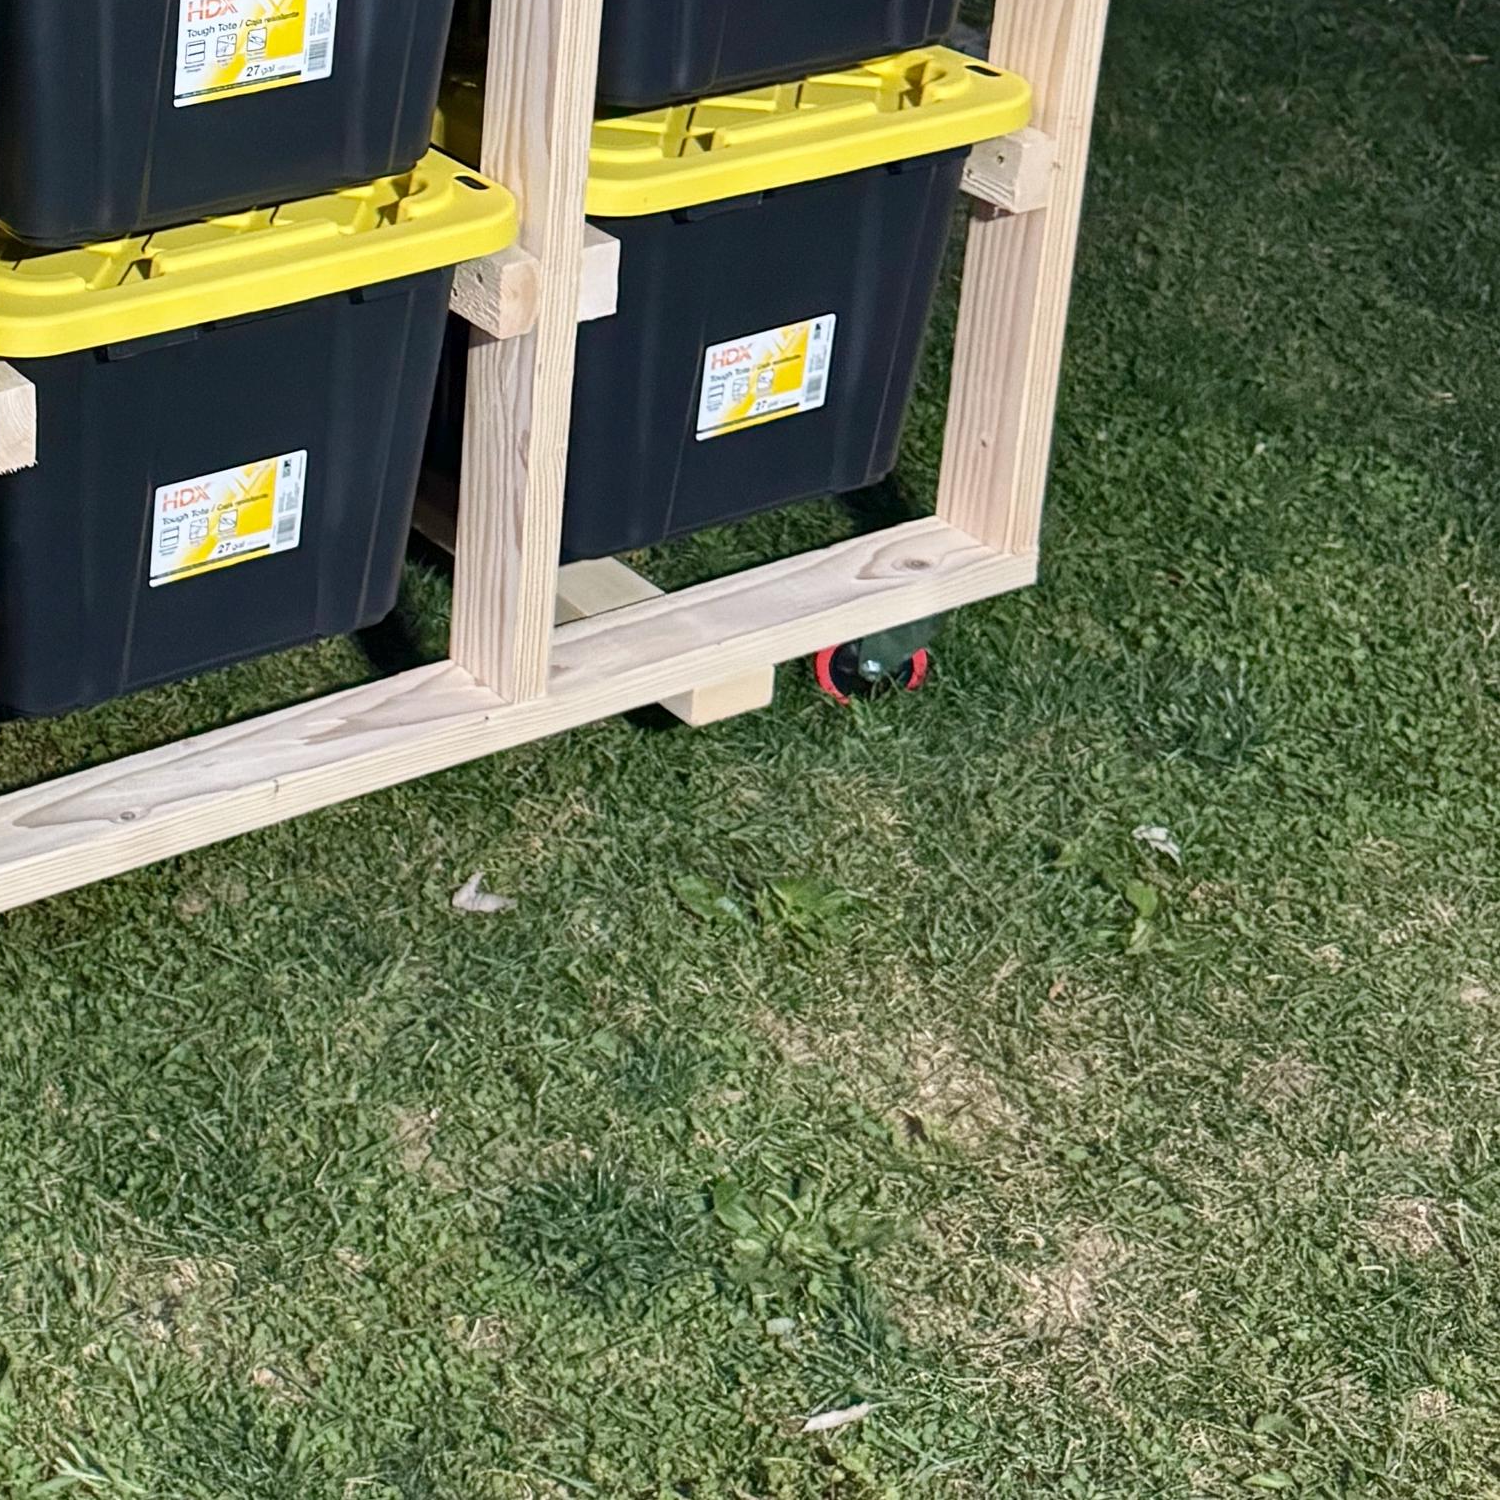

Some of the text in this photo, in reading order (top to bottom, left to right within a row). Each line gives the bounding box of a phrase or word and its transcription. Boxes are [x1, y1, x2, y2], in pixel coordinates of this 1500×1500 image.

[188, 26, 215, 38] Tough
[218, 23, 237, 31] Tote
[246, 65, 260, 76] 27
[711, 343, 753, 370] HDX
[163, 482, 211, 512] HDX
[218, 543, 231, 554] 27
